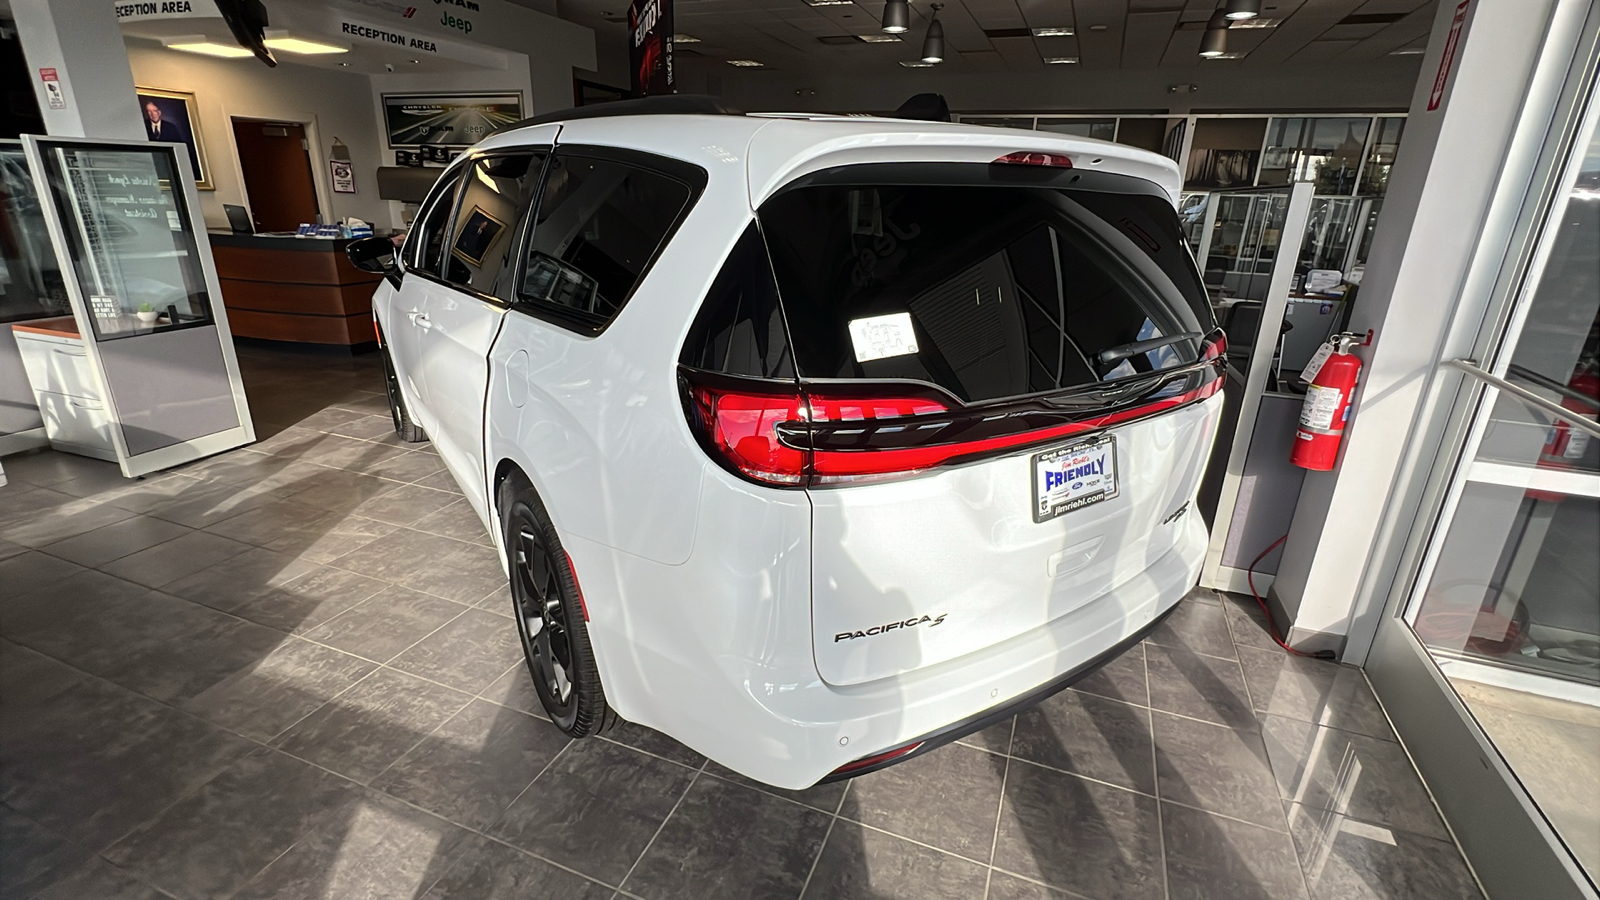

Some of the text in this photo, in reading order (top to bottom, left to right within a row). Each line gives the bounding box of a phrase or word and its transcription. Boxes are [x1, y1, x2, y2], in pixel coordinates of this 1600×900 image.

[115, 1, 192, 18] ECEPTION AREA
[440, 11, 473, 34] Jeep
[342, 22, 437, 53] RECEPTION AREA
[464, 125, 485, 135] Jeep
[1045, 453, 1105, 492] FRIENDLY
[1055, 493, 1104, 516] jimriehl.com
[834, 614, 932, 643] PACIFICA
